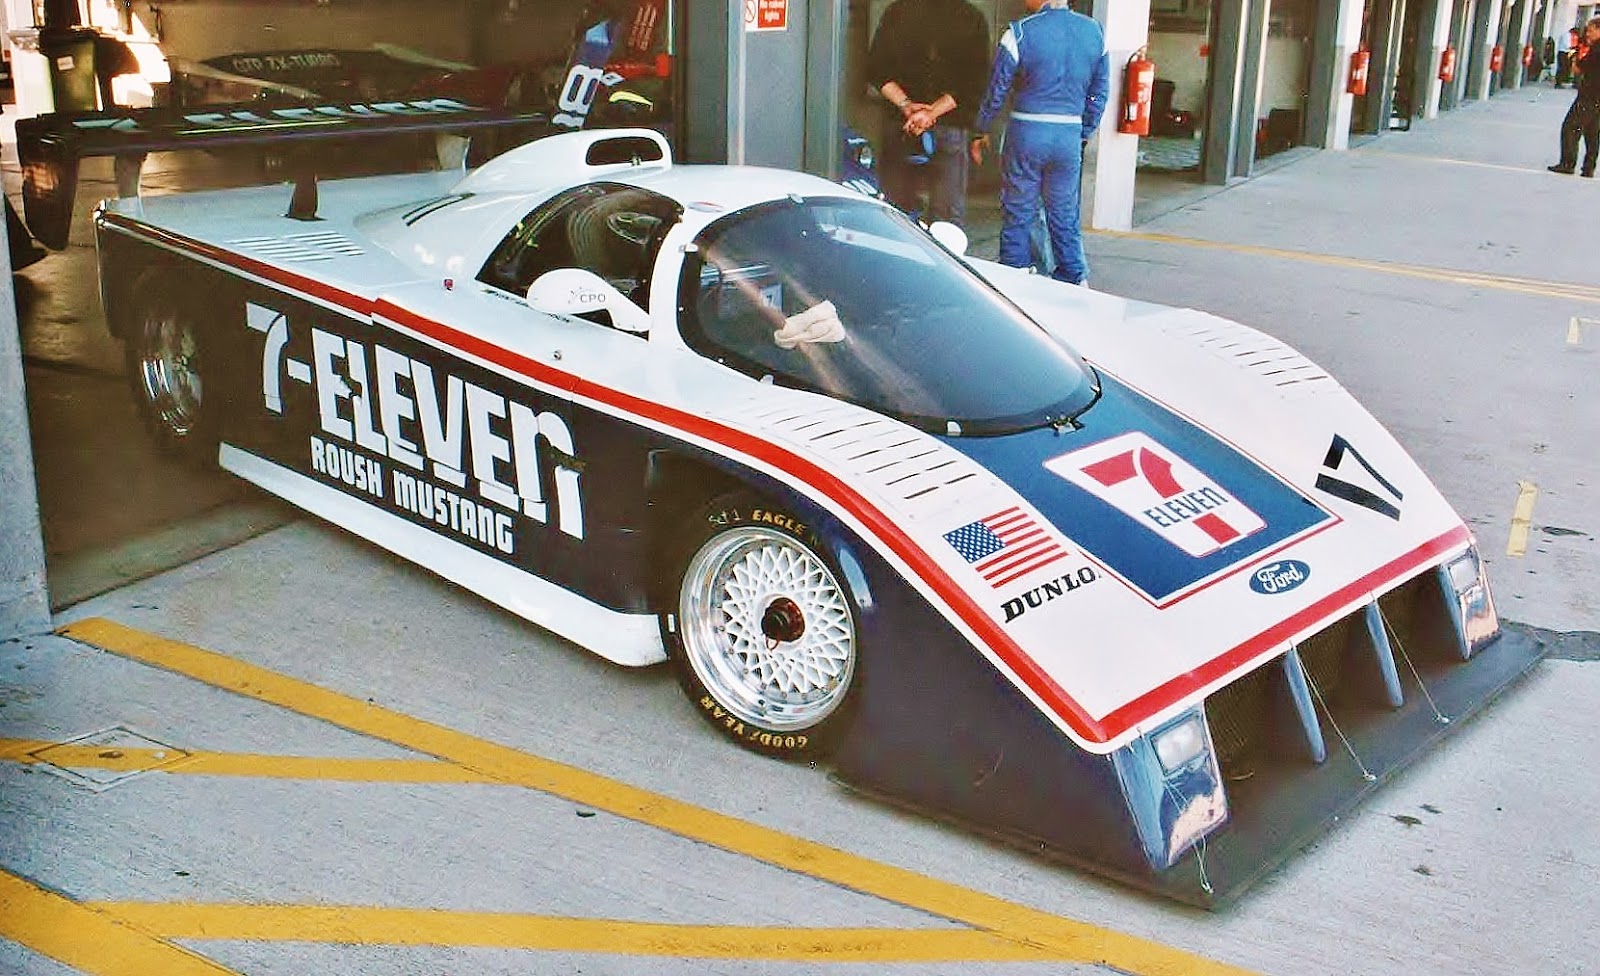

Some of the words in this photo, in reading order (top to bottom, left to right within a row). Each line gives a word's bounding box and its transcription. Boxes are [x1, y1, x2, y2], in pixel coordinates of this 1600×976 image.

[580, 293, 606, 303] CPO
[310, 435, 384, 499] ROUSH
[393, 469, 514, 555] MUSTANG
[752, 508, 808, 537] EAGLE
[1256, 562, 1304, 593] Ford
[1001, 566, 1101, 624] DUNLO
